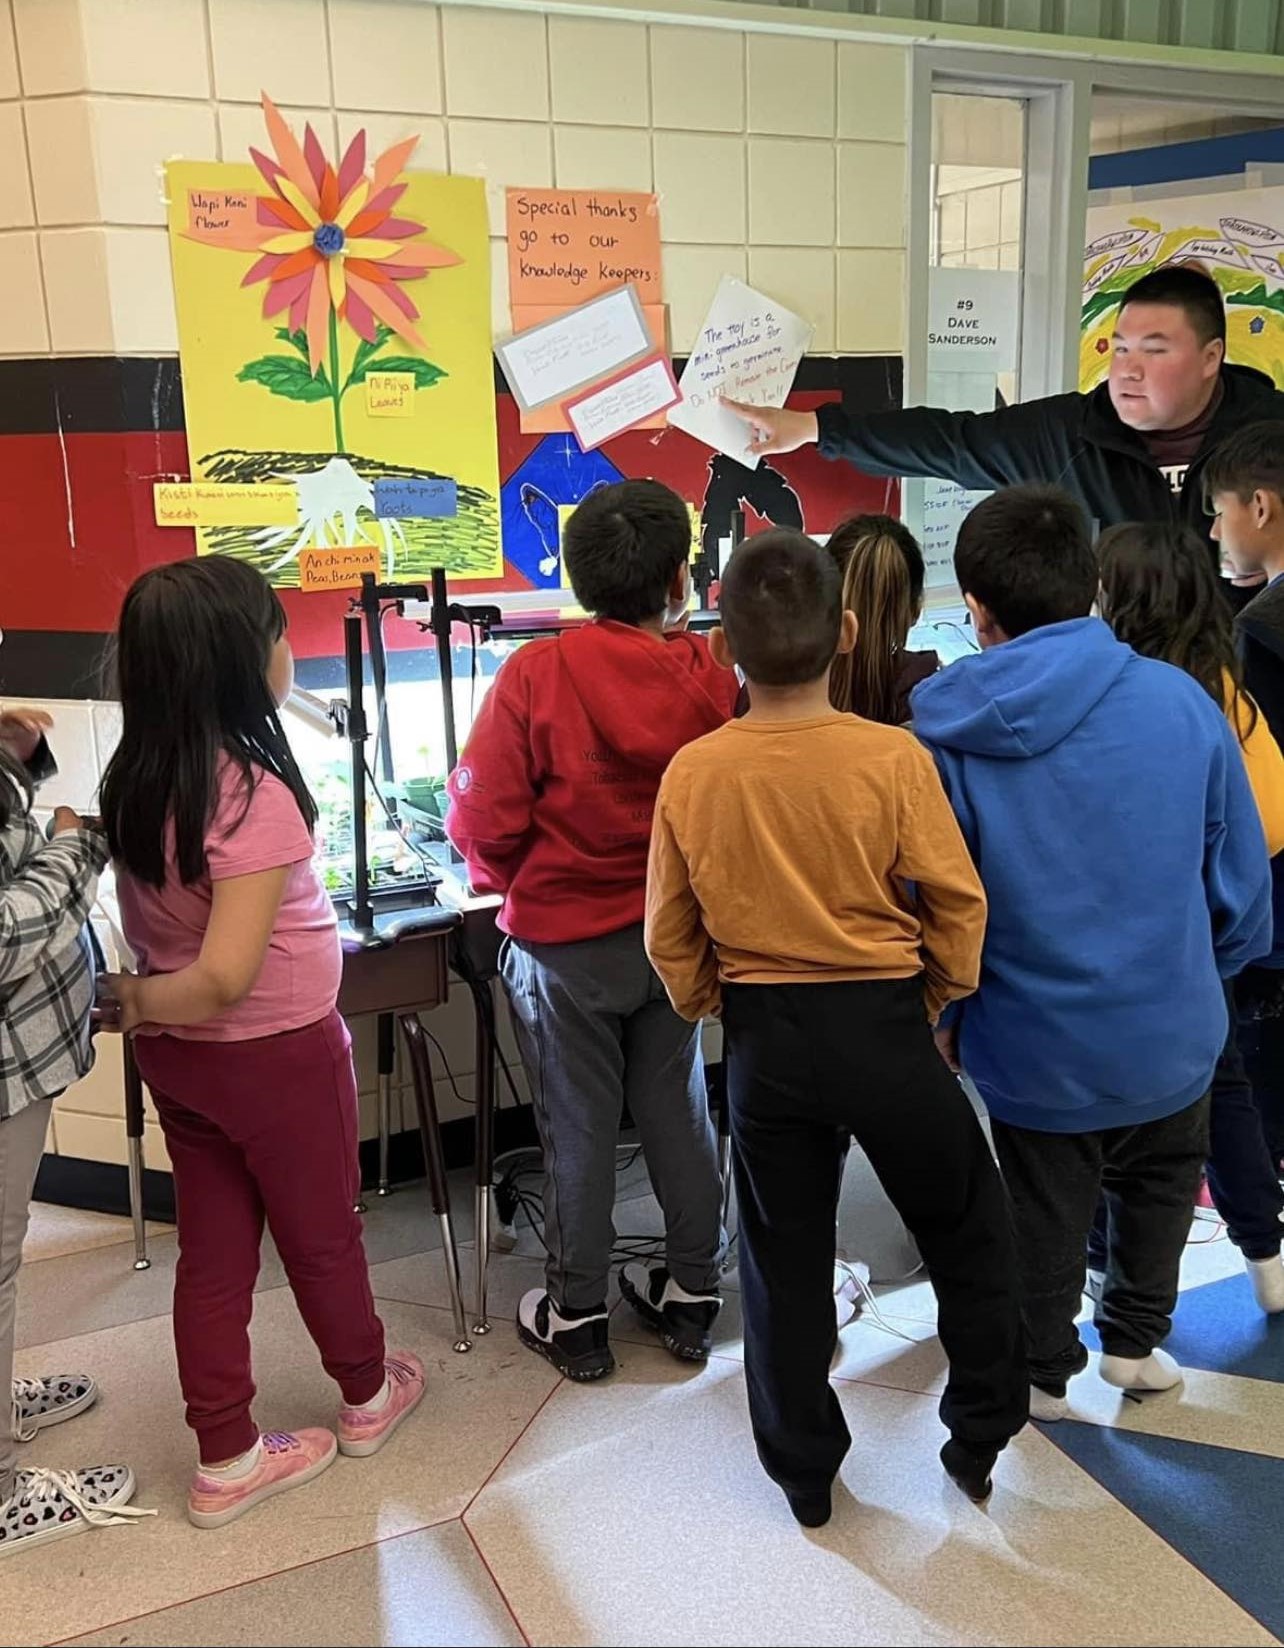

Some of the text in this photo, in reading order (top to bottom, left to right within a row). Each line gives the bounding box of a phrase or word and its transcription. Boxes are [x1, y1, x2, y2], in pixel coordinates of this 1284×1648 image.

[517, 197, 638, 223] Special thanks
[516, 230, 619, 253] go to our
[957, 300, 974, 311] #9
[704, 327, 723, 344] The
